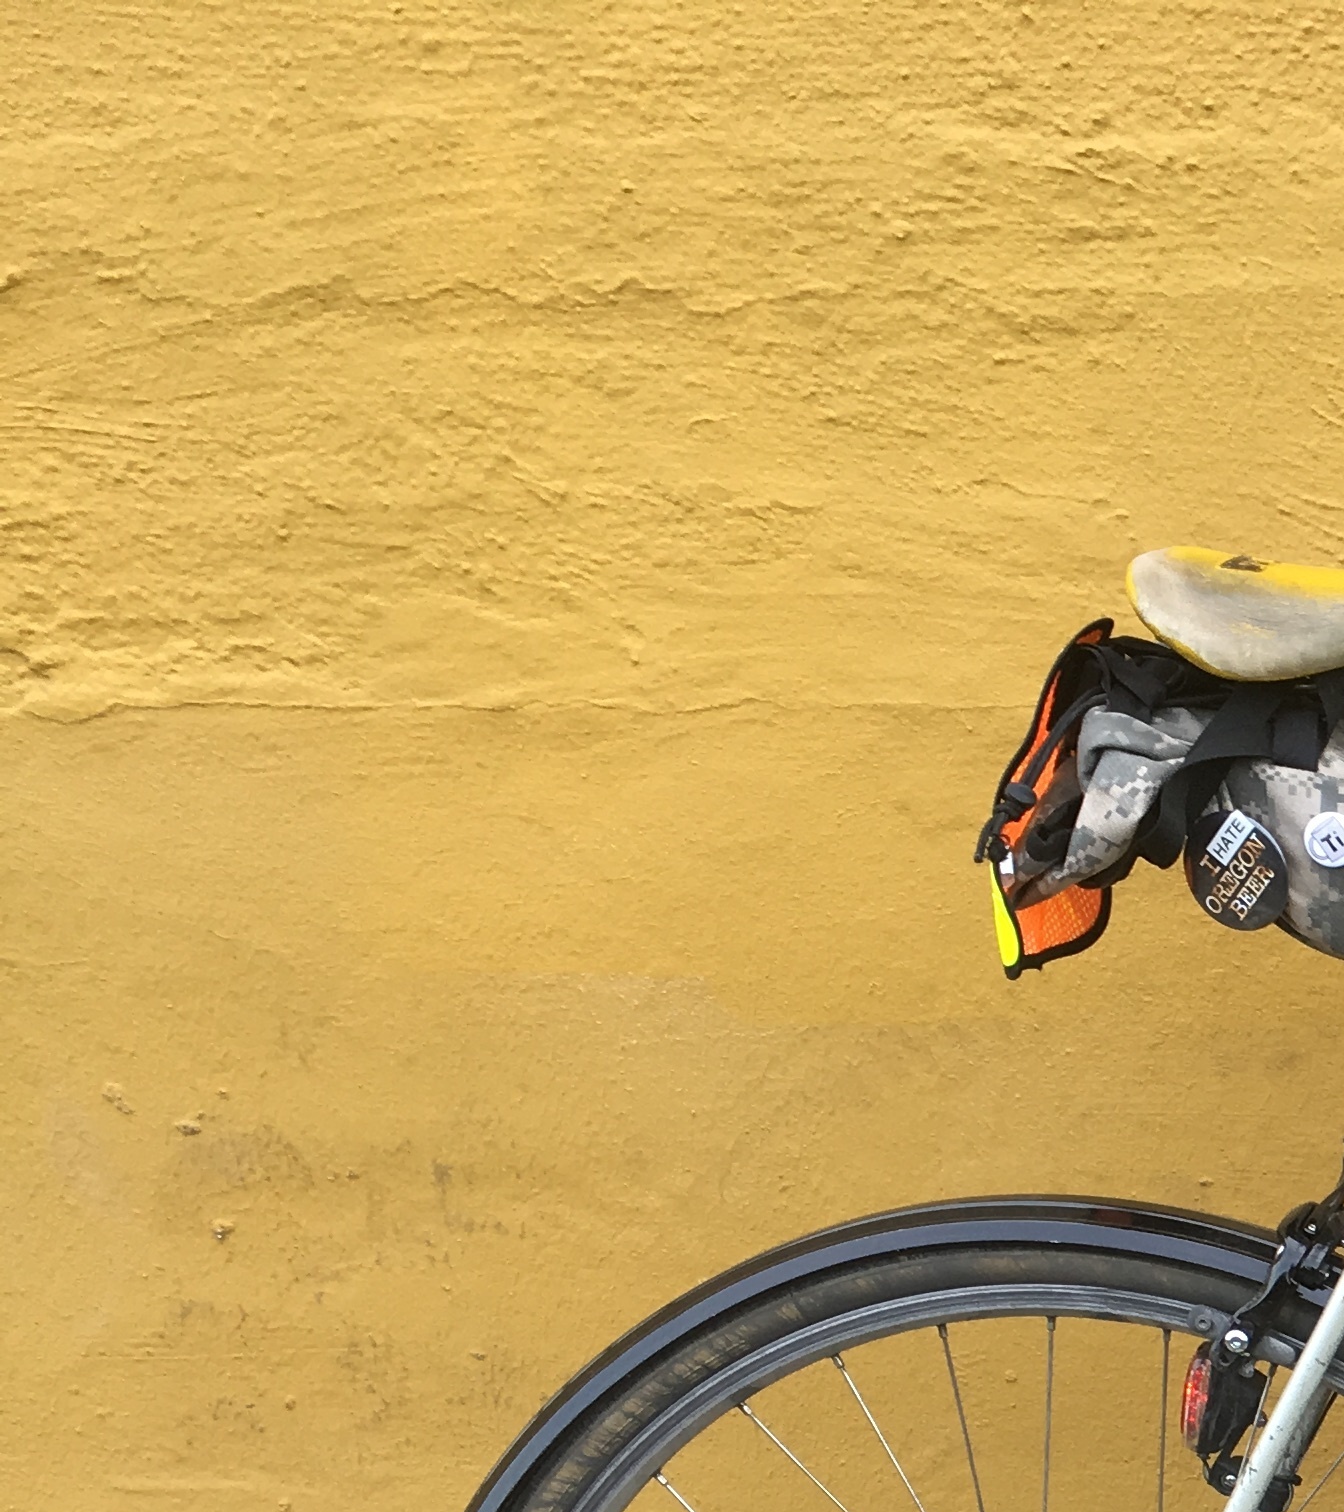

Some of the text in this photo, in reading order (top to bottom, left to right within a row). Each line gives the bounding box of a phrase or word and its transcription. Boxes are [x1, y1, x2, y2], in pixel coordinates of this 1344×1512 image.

[1199, 817, 1246, 877] I HATE
[1205, 833, 1266, 914] OREGON
[1229, 865, 1275, 922] BEER
